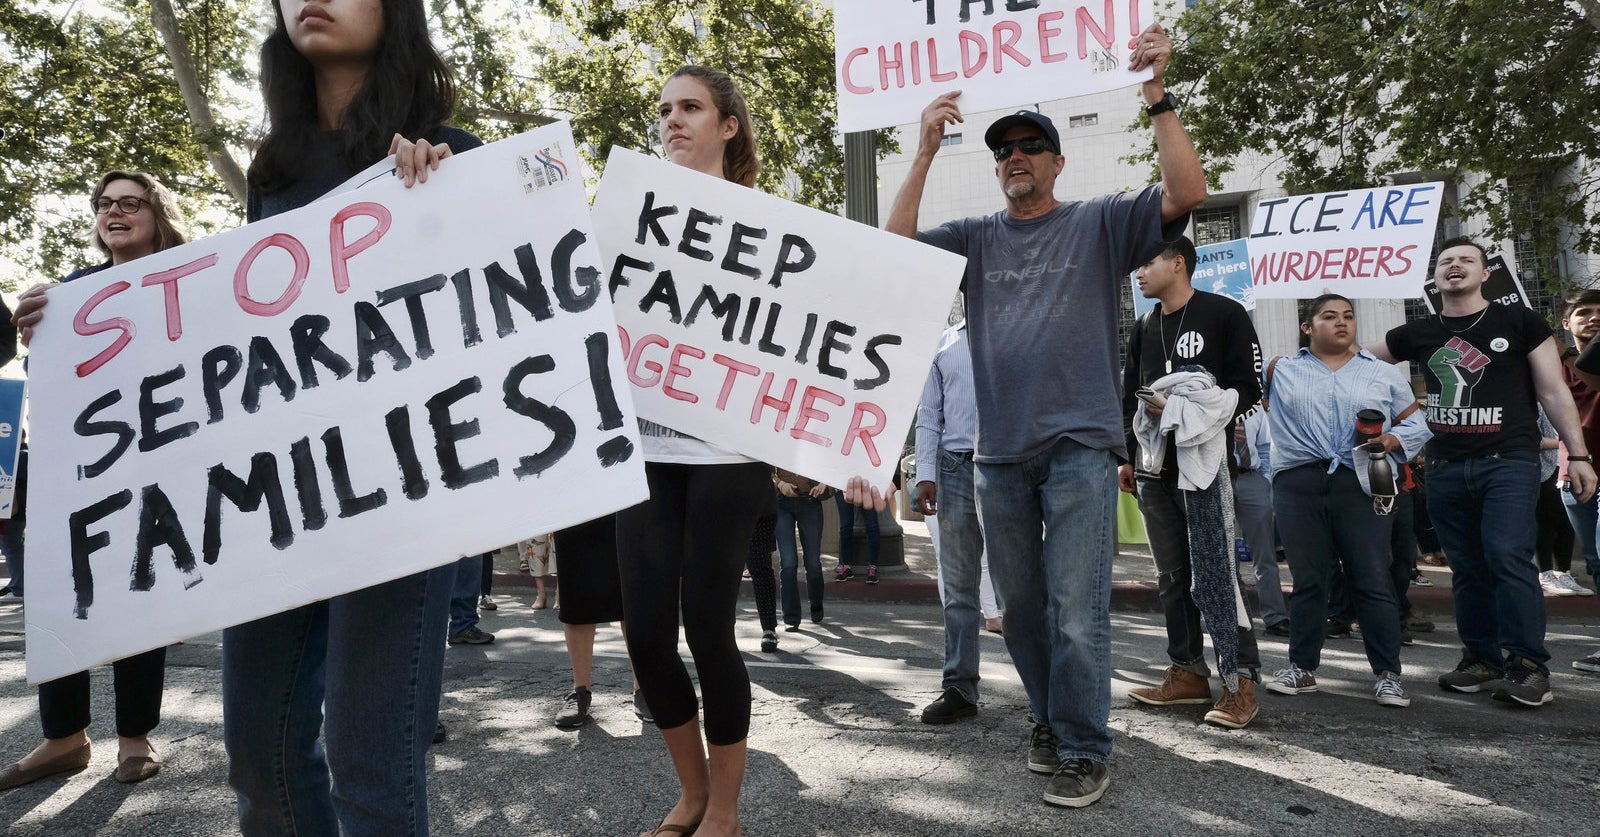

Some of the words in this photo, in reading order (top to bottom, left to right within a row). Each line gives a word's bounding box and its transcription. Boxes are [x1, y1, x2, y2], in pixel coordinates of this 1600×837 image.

[635, 191, 817, 288] KEEP
[1216, 261, 1247, 275] here
[1250, 193, 1348, 238] I.C.E.
[1350, 186, 1435, 231] ARE
[1251, 244, 1418, 286] MURDERERS
[73, 201, 392, 377] STOP
[609, 254, 902, 390] FAMILIES
[74, 229, 602, 480] SEPARATING
[69, 332, 635, 620] FAMILIES!
